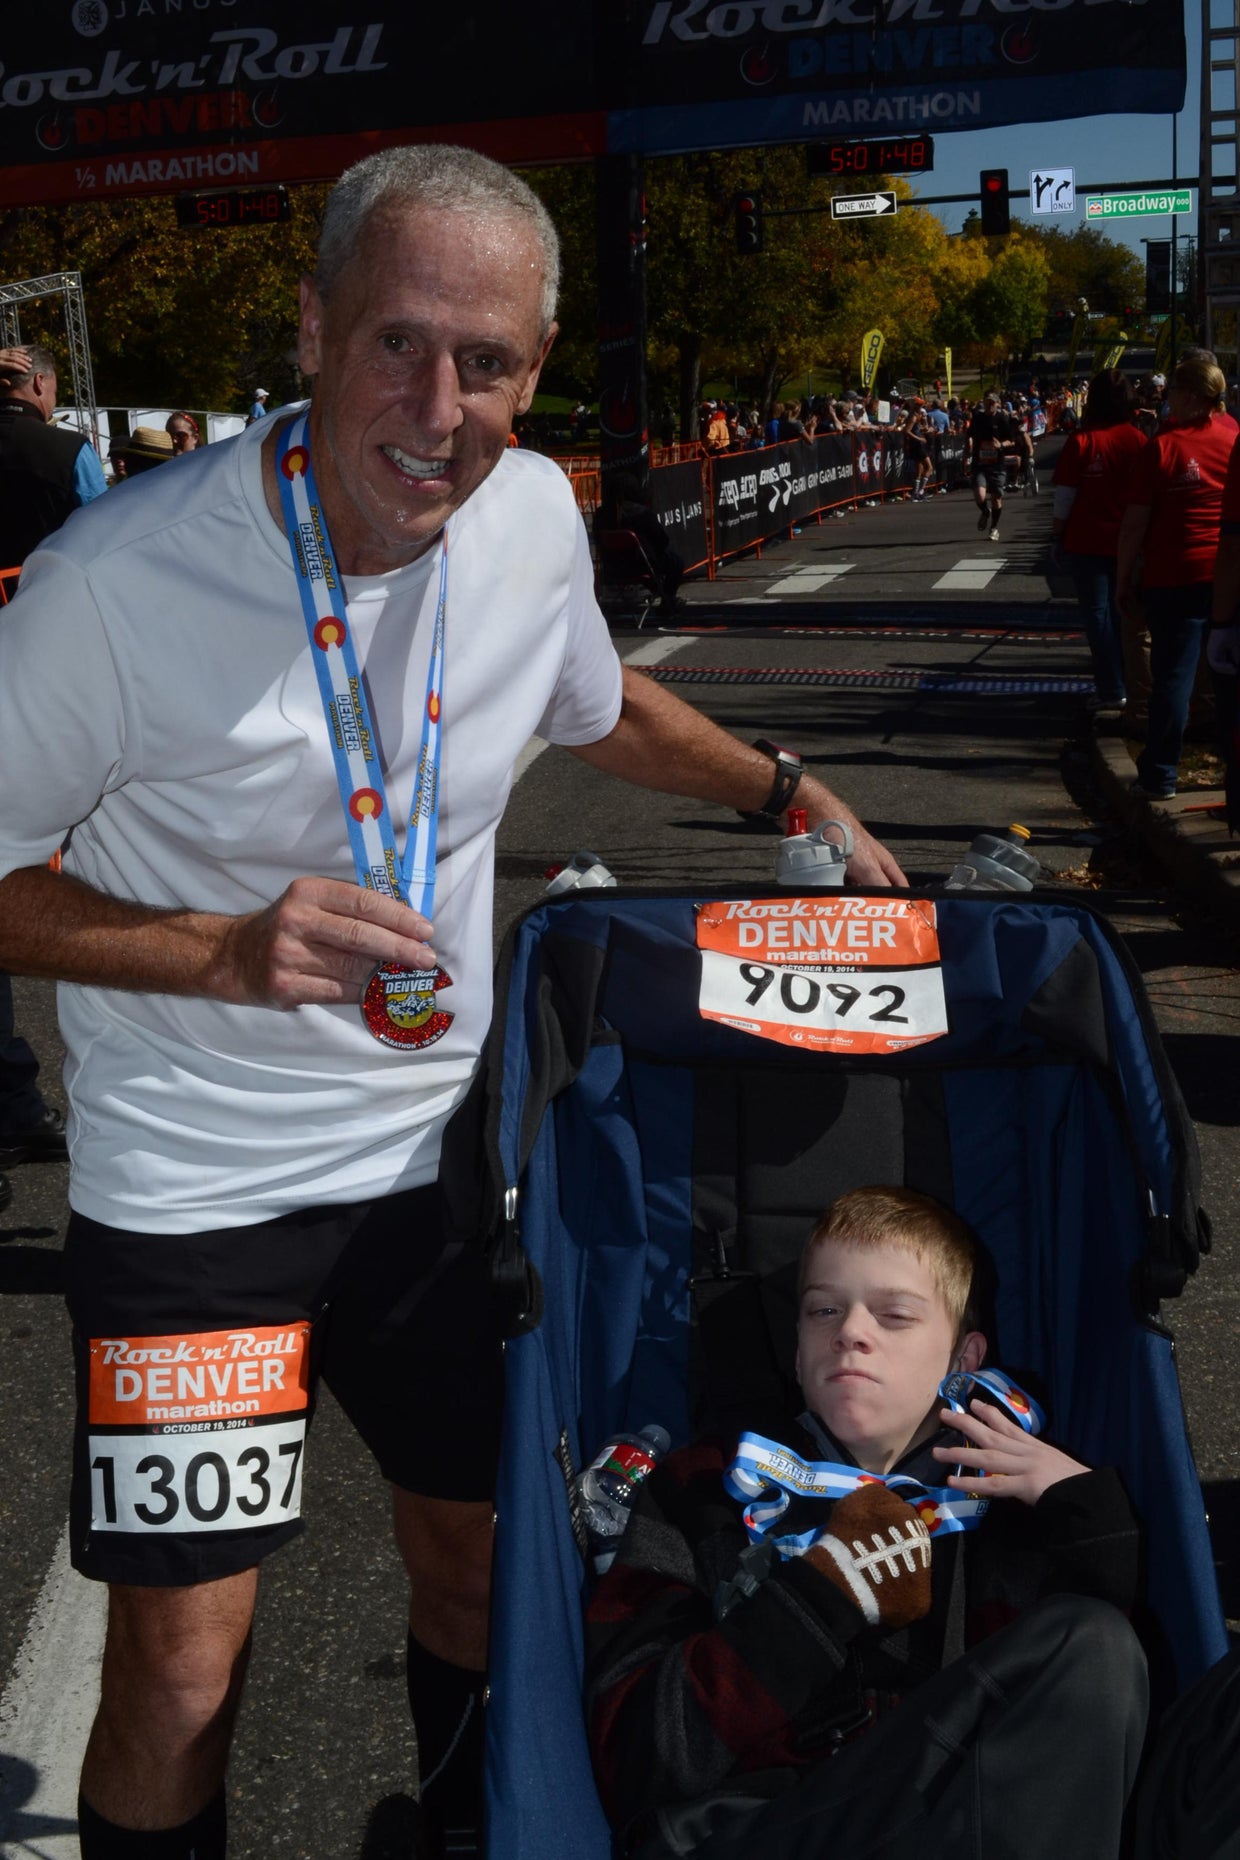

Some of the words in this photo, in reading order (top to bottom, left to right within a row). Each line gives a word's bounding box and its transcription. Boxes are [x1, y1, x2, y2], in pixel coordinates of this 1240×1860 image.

[114, 0, 238, 19] JAN
[641, 0, 875, 45] Rock
[0, 50, 147, 107] ock
[209, 23, 390, 85] Roll
[788, 22, 999, 79] DENVER
[75, 91, 253, 145] DENVER
[803, 90, 981, 126] MARATHON
[105, 151, 259, 186] MARATHON
[838, 203, 855, 212] ONE
[858, 201, 876, 210] WAY
[1053, 202, 1073, 210] ONLY
[1103, 195, 1176, 213] Broadway
[864, 334, 881, 385] GEICO
[300, 522, 324, 582] DENVER
[336, 694, 360, 753] DENVER
[420, 759, 434, 819] DENVER
[371, 865, 394, 900] DEN
[722, 900, 813, 920] Rock
[838, 897, 912, 919] Roll
[738, 920, 897, 948] DENVER
[766, 948, 868, 962] marathon
[781, 963, 822, 972] OCTOBER
[386, 979, 434, 994] DENVER
[739, 963, 909, 1024] 9092
[380, 1033, 416, 1048] MARATHON
[101, 1340, 200, 1365] Rock
[227, 1332, 298, 1359] Roll
[115, 1359, 285, 1402] DENVER
[147, 1400, 260, 1420] marathon
[163, 1422, 211, 1434] OCTOBER
[213, 1421, 225, 1432] 19,
[226, 1419, 246, 1429] 2014
[92, 1440, 304, 1525] 13037
[769, 1452, 816, 1485] DENVER
